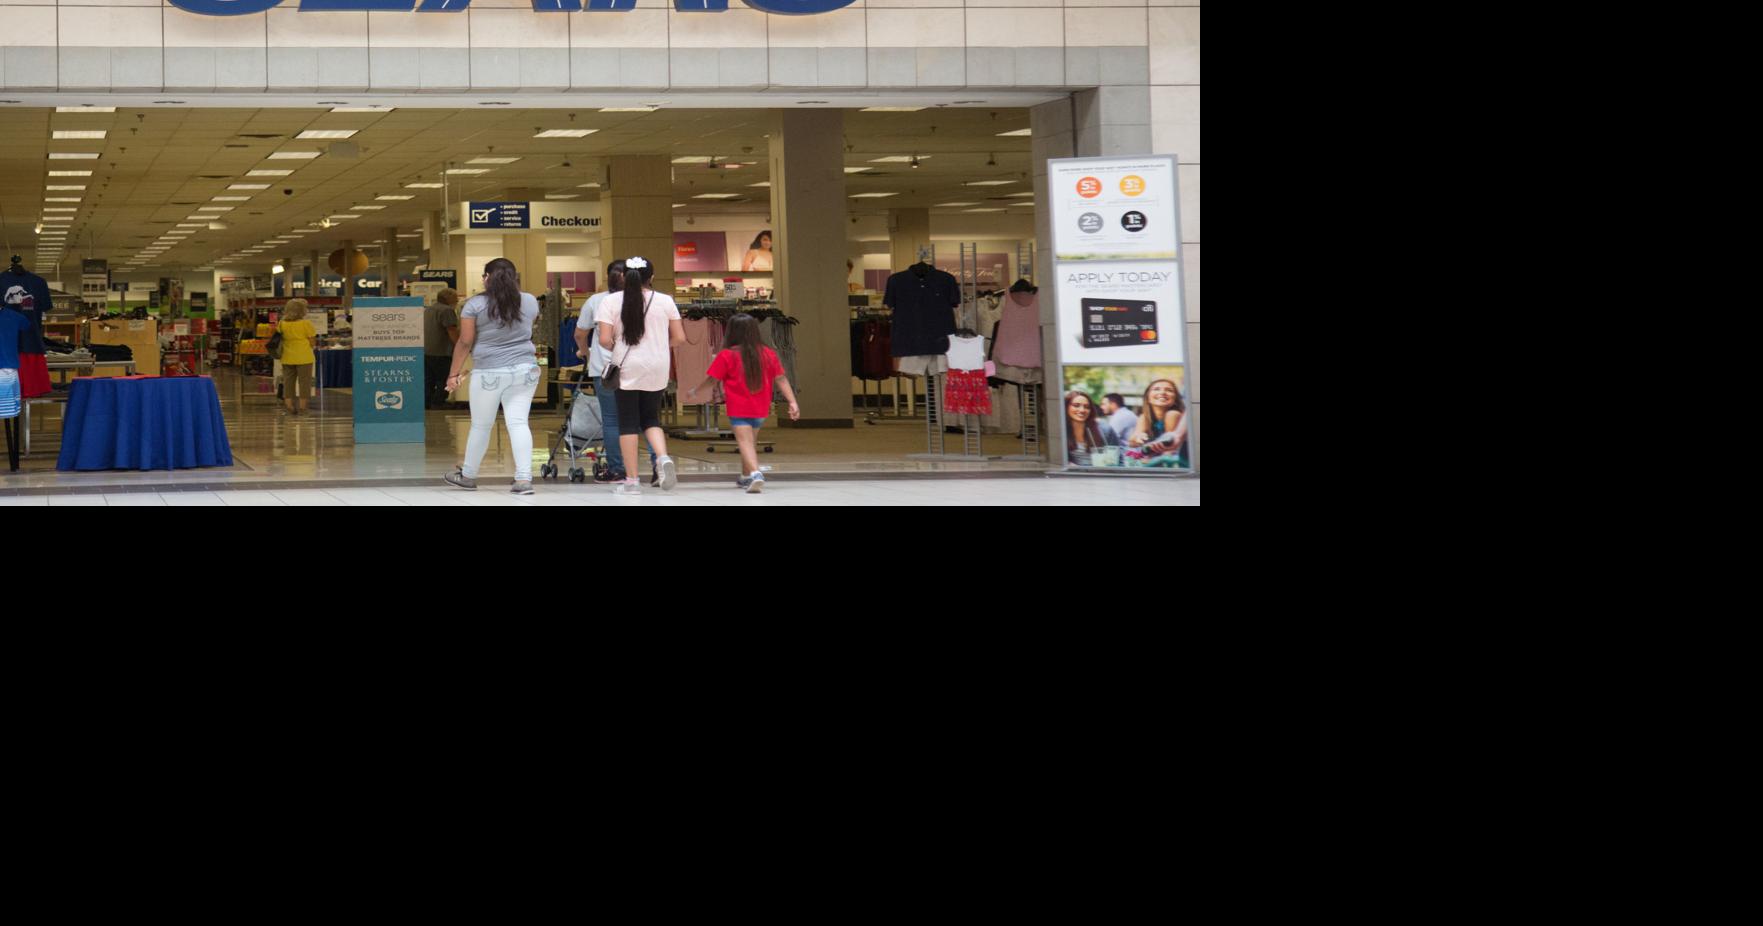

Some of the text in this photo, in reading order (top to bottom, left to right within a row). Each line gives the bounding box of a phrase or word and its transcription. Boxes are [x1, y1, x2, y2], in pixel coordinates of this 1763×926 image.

[1067, 271, 1171, 284] APPLY TODAY
[371, 313, 406, 322] sears
[364, 369, 411, 377] STEARNS
